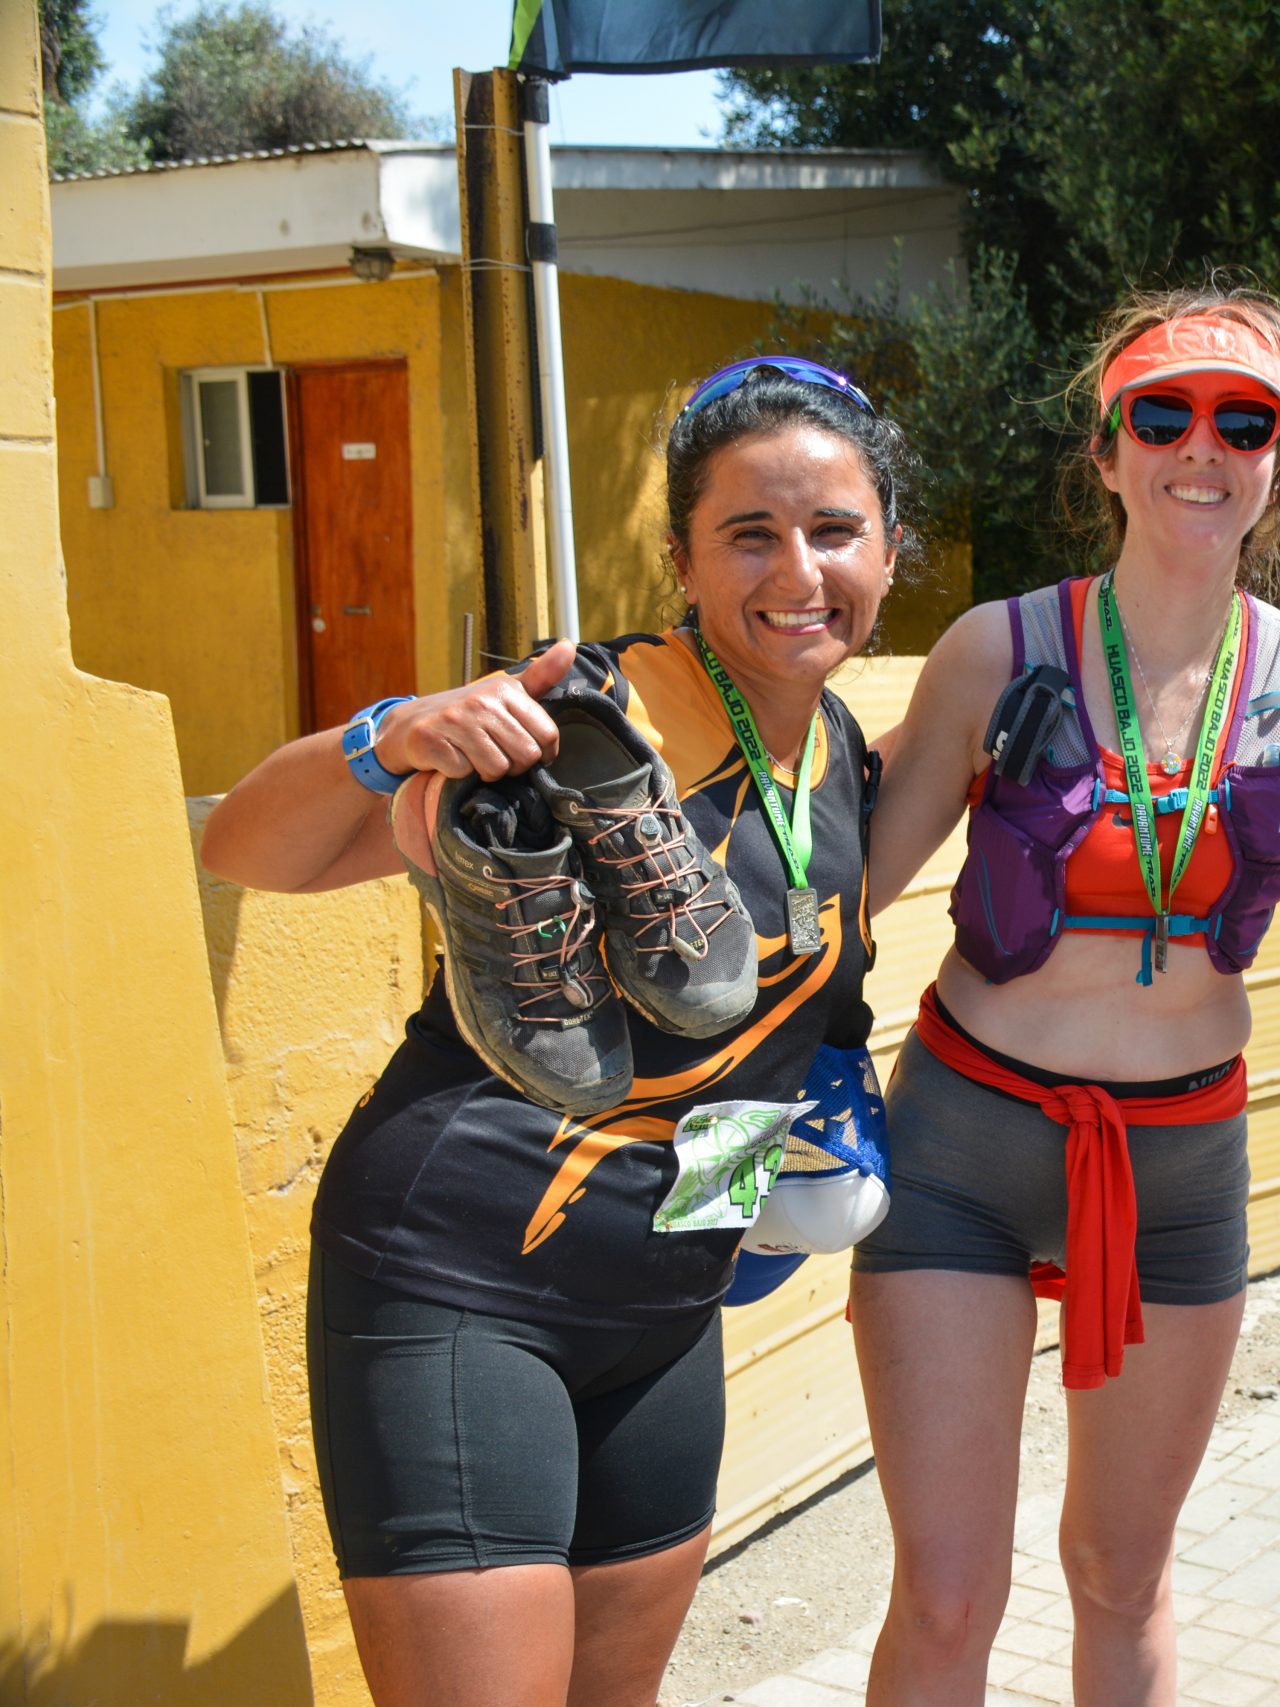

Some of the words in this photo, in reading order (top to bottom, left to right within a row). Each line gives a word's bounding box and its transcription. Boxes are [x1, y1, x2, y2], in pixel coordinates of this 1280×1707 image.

[1107, 644, 1128, 706] HUASCO
[1215, 651, 1234, 713] HUASCO
[714, 670, 746, 717] BAJO
[737, 717, 762, 761] 2022
[1118, 709, 1136, 752] BAJO
[1206, 713, 1222, 754] BAJO
[758, 771, 786, 828] PAYANTUME
[1126, 755, 1144, 793] 2022
[1196, 755, 1213, 791] 2022
[1135, 803, 1153, 857] PAYANTUME
[1182, 798, 1203, 850] PAYANTUME
